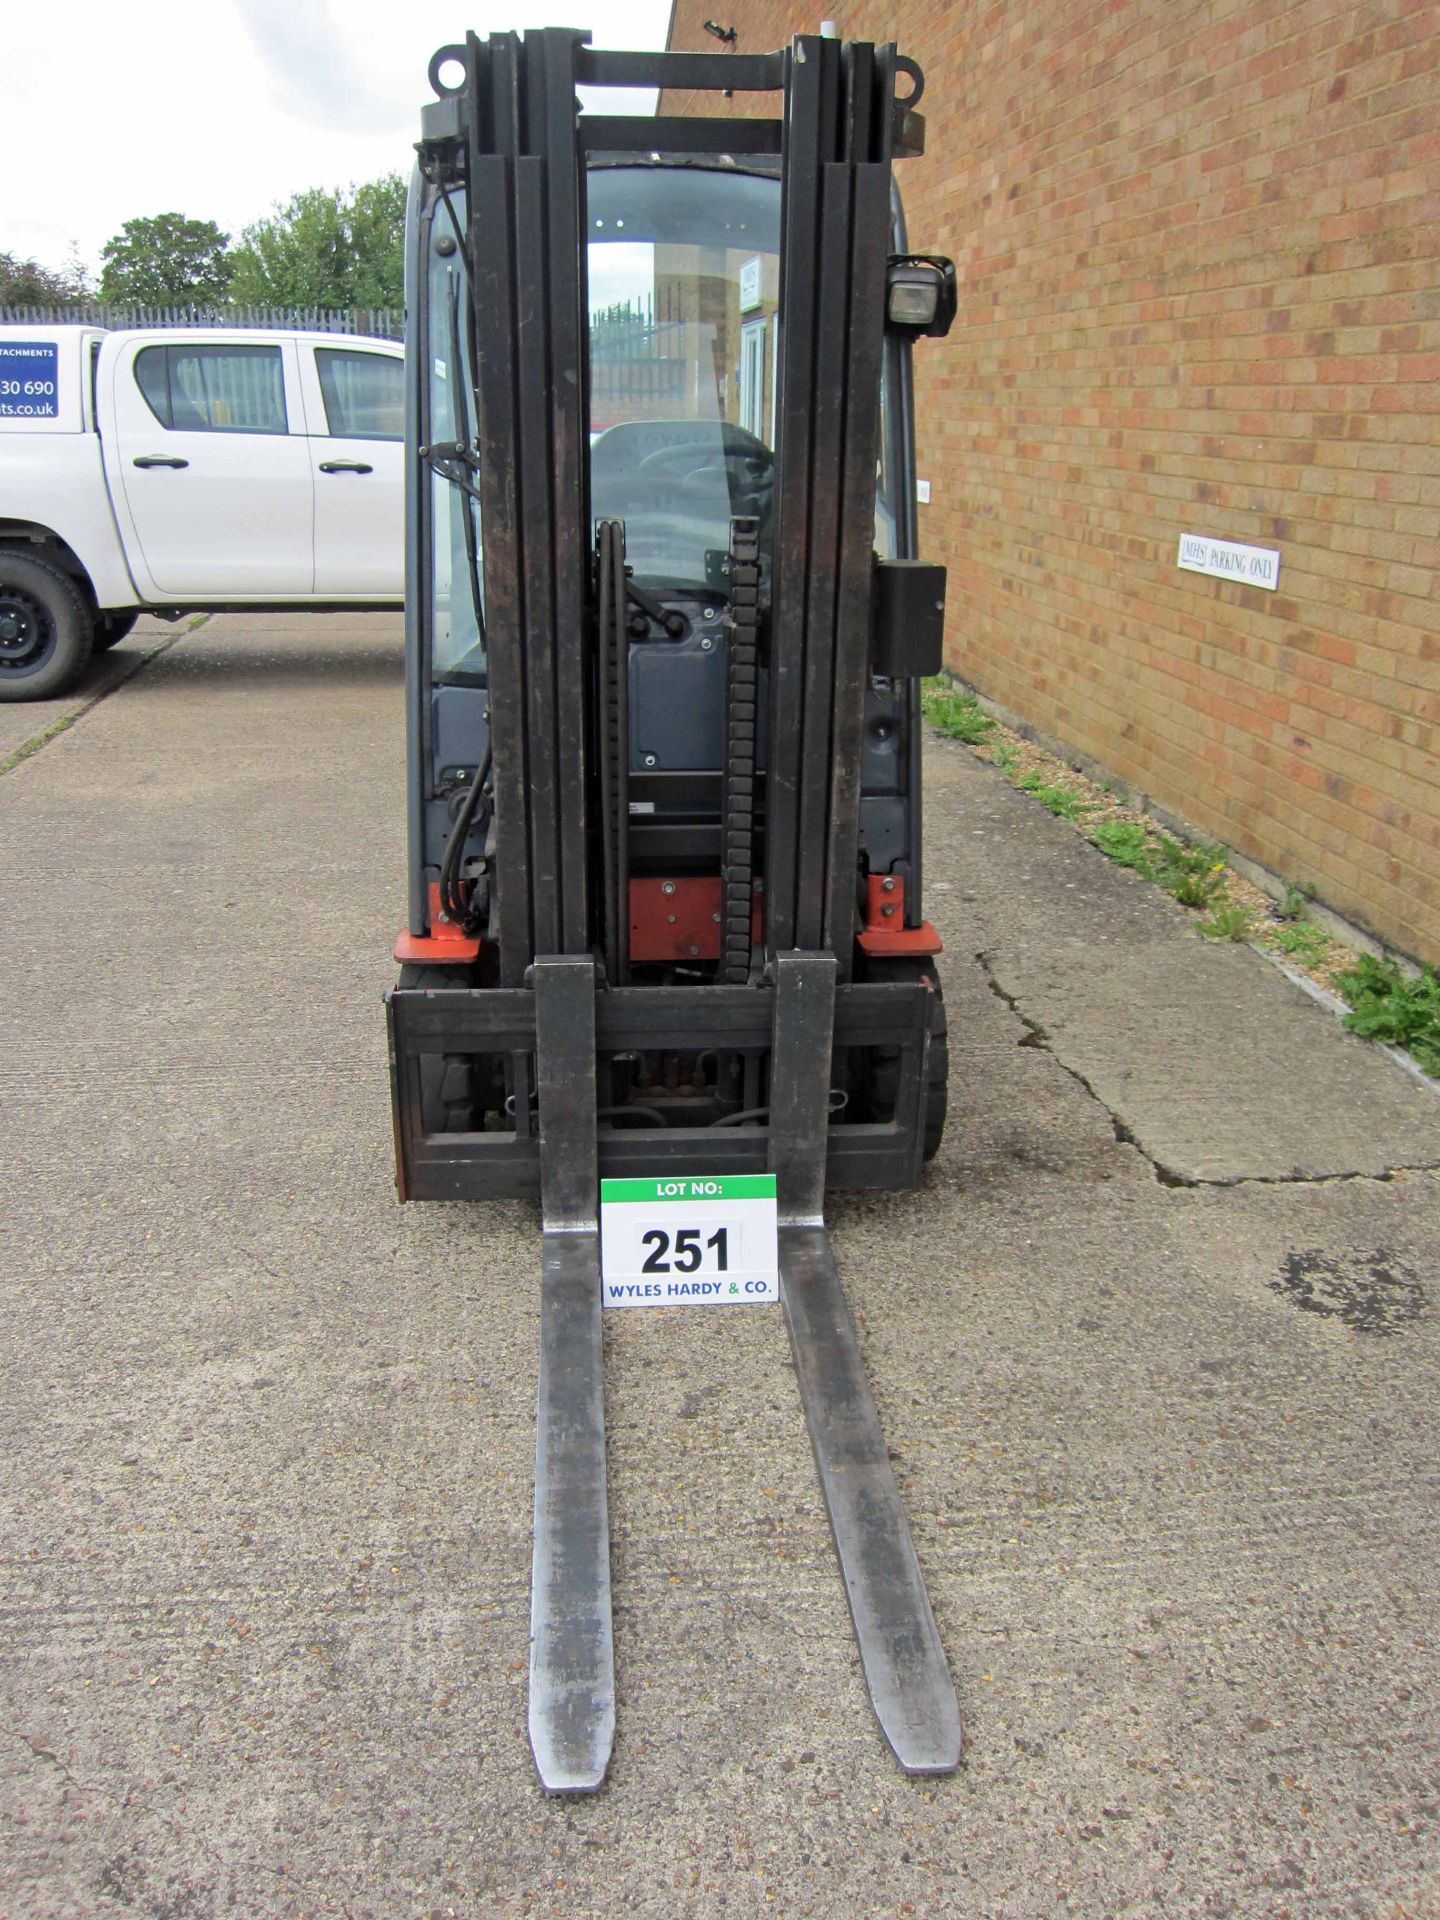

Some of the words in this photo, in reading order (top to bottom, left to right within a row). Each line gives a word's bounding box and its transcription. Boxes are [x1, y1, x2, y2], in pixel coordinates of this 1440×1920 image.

[0, 380, 20, 395] 30
[24, 381, 54, 396] 690
[1210, 548, 1246, 574] PARKING
[1250, 557, 1275, 580] ONLY
[656, 1183, 686, 1197] LOT
[691, 1182, 723, 1195] NO:
[641, 1227, 728, 1274] 251
[609, 1284, 662, 1298] WYLES
[667, 1282, 722, 1296] HARDY
[728, 1282, 739, 1294] &
[744, 1281, 772, 1294] CO.
